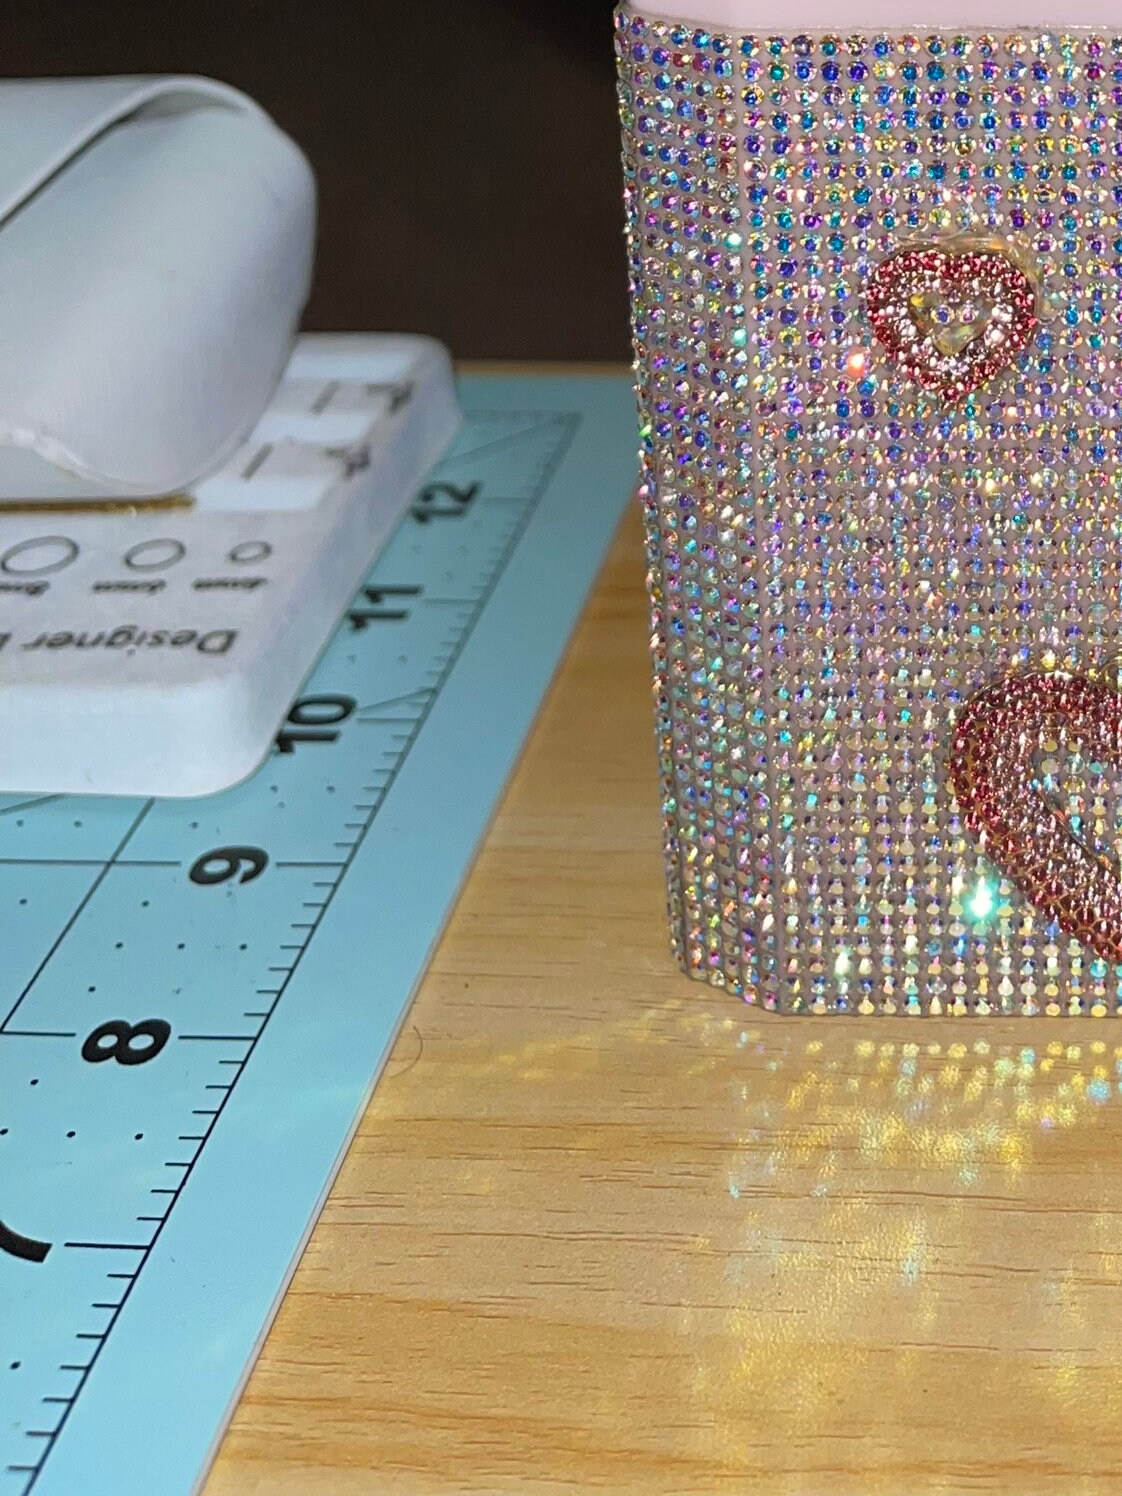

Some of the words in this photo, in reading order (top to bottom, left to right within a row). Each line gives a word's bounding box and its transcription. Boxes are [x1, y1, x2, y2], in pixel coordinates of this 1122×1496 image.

[410, 480, 483, 526] 12
[346, 584, 423, 632] 11
[20, 624, 240, 655] Designer
[274, 693, 359, 755] 10
[188, 845, 270, 887] 9
[81, 1018, 172, 1066] 8
